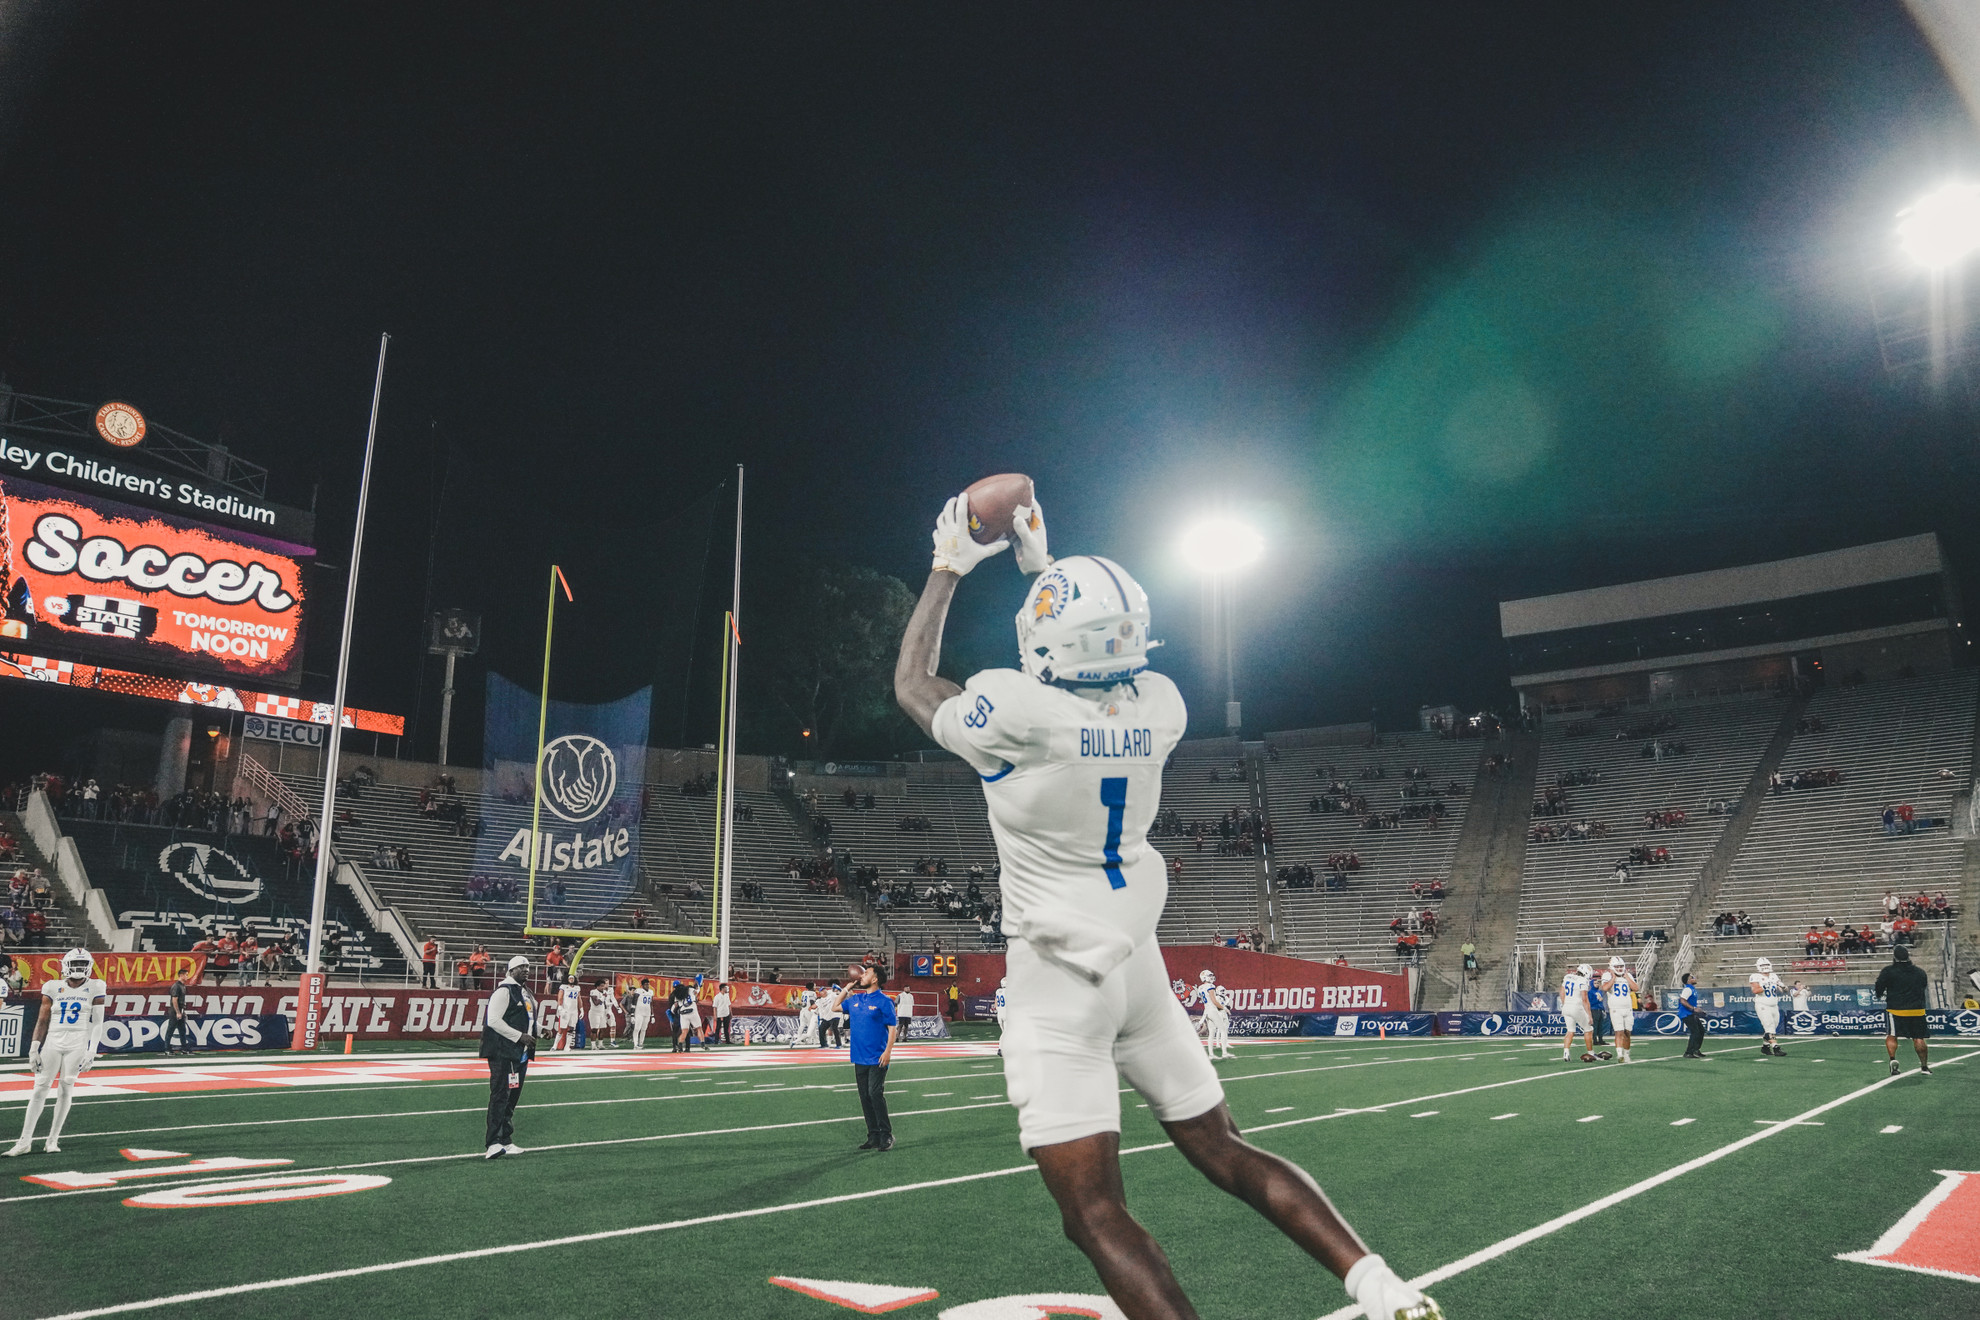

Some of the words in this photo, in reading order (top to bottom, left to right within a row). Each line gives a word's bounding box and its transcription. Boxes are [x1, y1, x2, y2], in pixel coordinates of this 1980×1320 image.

[116, 404, 144, 428] MOUNTAIN
[46, 452, 172, 501] Children's
[177, 483, 275, 525] Stadium
[26, 515, 293, 610] Soccer
[76, 606, 142, 633] STATE
[173, 610, 288, 642] TOMORROW
[190, 631, 268, 659] NOON
[266, 720, 323, 745] EECU
[1081, 728, 1151, 757] BULLARD
[1100, 777, 1128, 890] 1
[498, 827, 630, 872] Allstate
[933, 955, 957, 975] 25
[1321, 985, 1388, 1008] BRED.
[1564, 981, 1575, 997] 51
[1614, 983, 1628, 997] 59
[59, 1001, 82, 1024] 13
[304, 977, 321, 1048] BULLDOGS
[1240, 1020, 1300, 1029] MOUNTAIN
[1507, 1014, 1543, 1025] SIERRA
[1821, 1012, 1886, 1024] Balanced
[1360, 1020, 1409, 1031] TOYOTA
